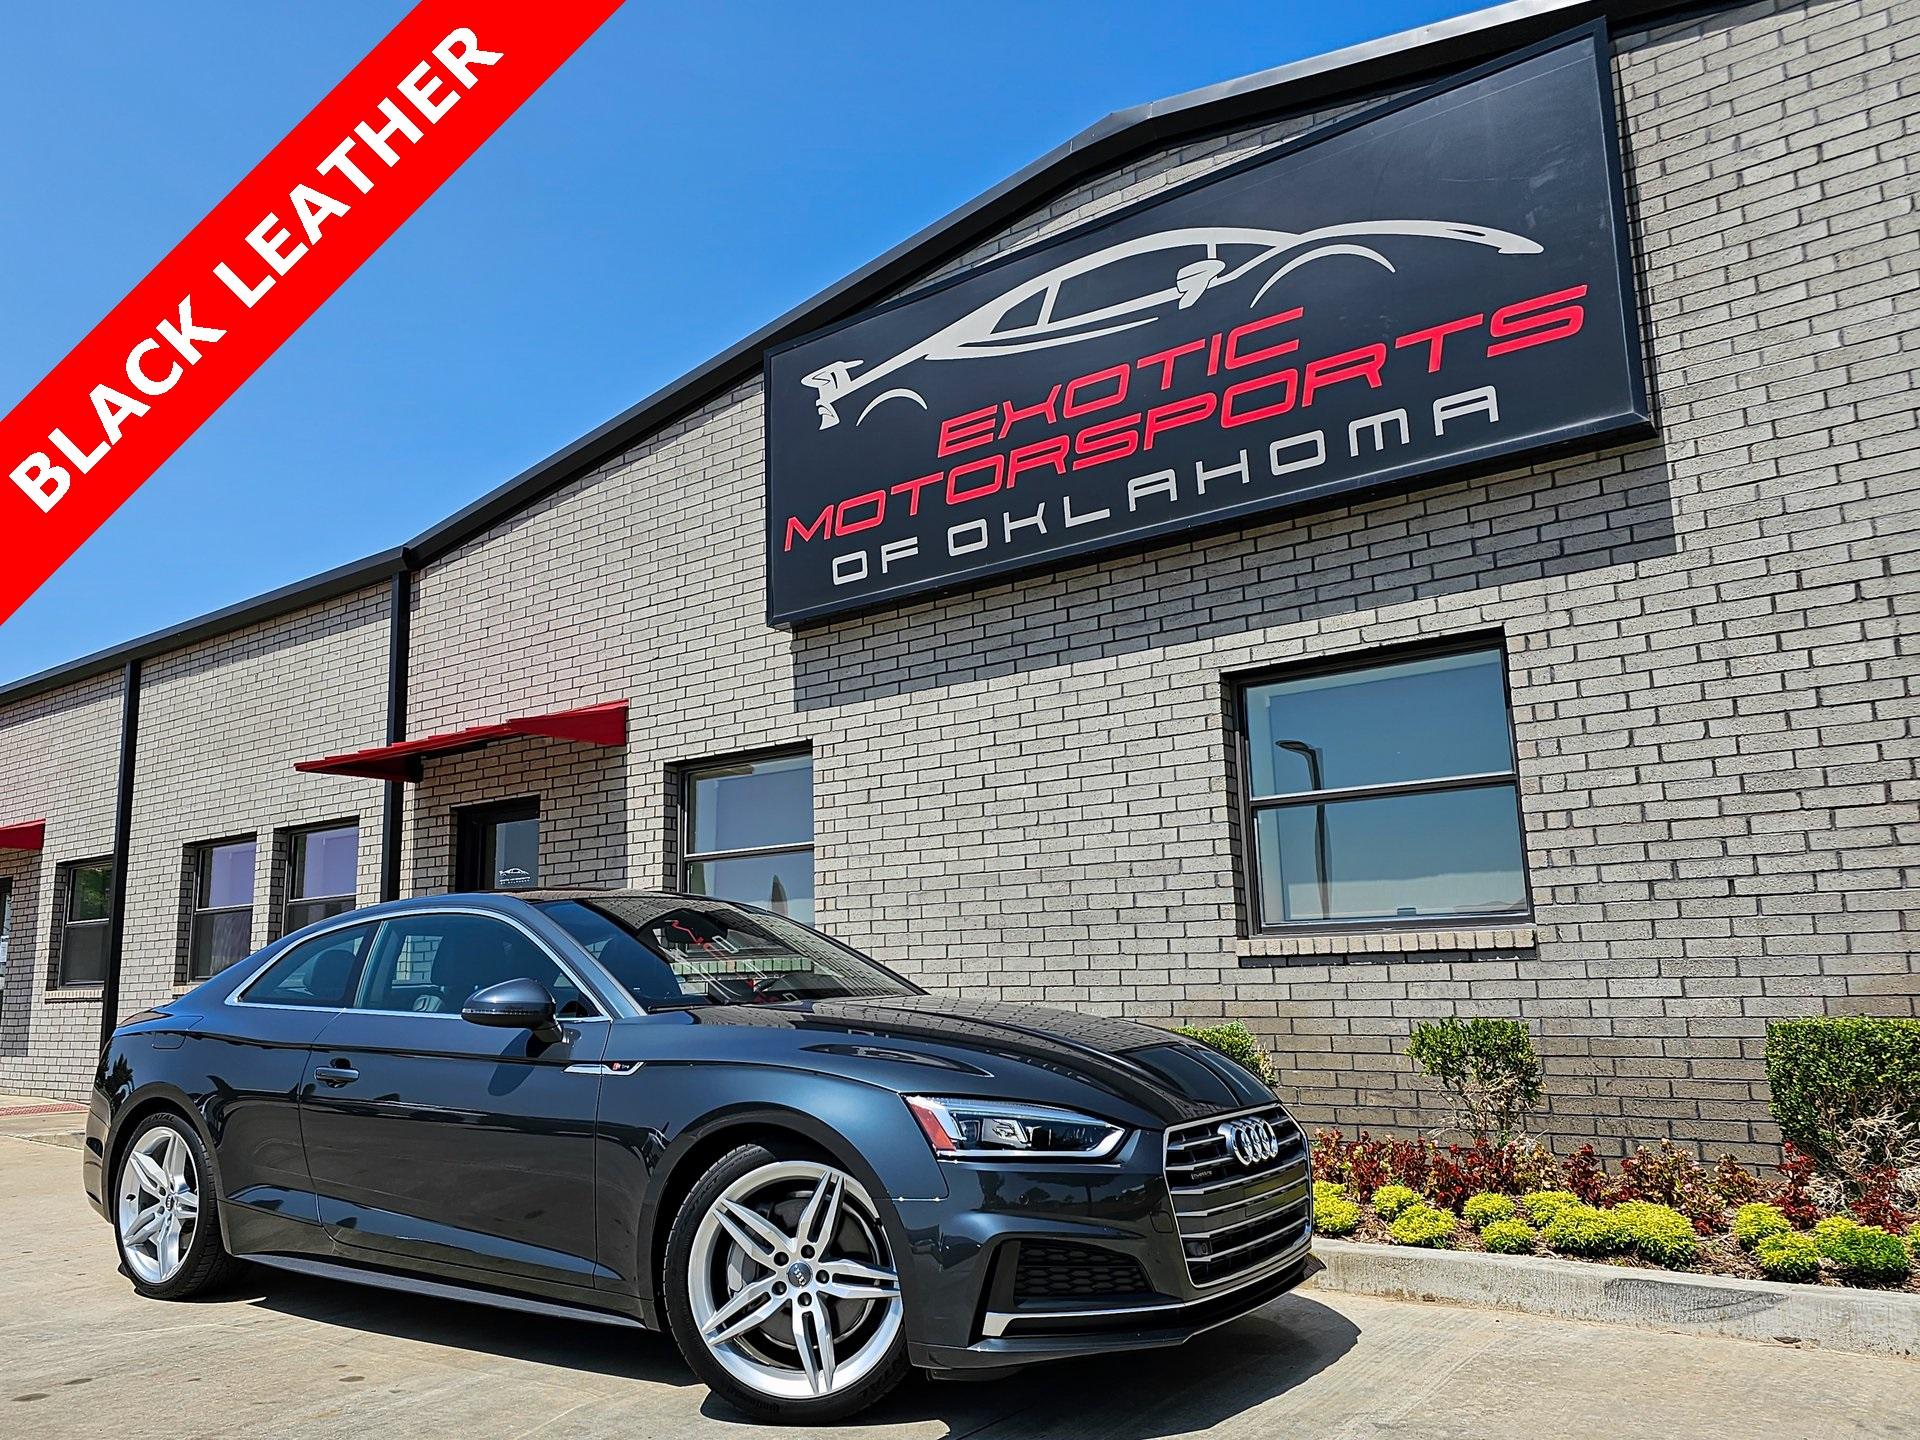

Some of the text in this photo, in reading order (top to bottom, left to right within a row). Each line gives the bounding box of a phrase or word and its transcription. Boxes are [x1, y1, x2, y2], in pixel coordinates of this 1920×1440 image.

[784, 285, 1588, 552] MOTORSPORTS
[937, 308, 1304, 458] EXOTIC
[832, 386, 1499, 586] OF OKLAHOMA
